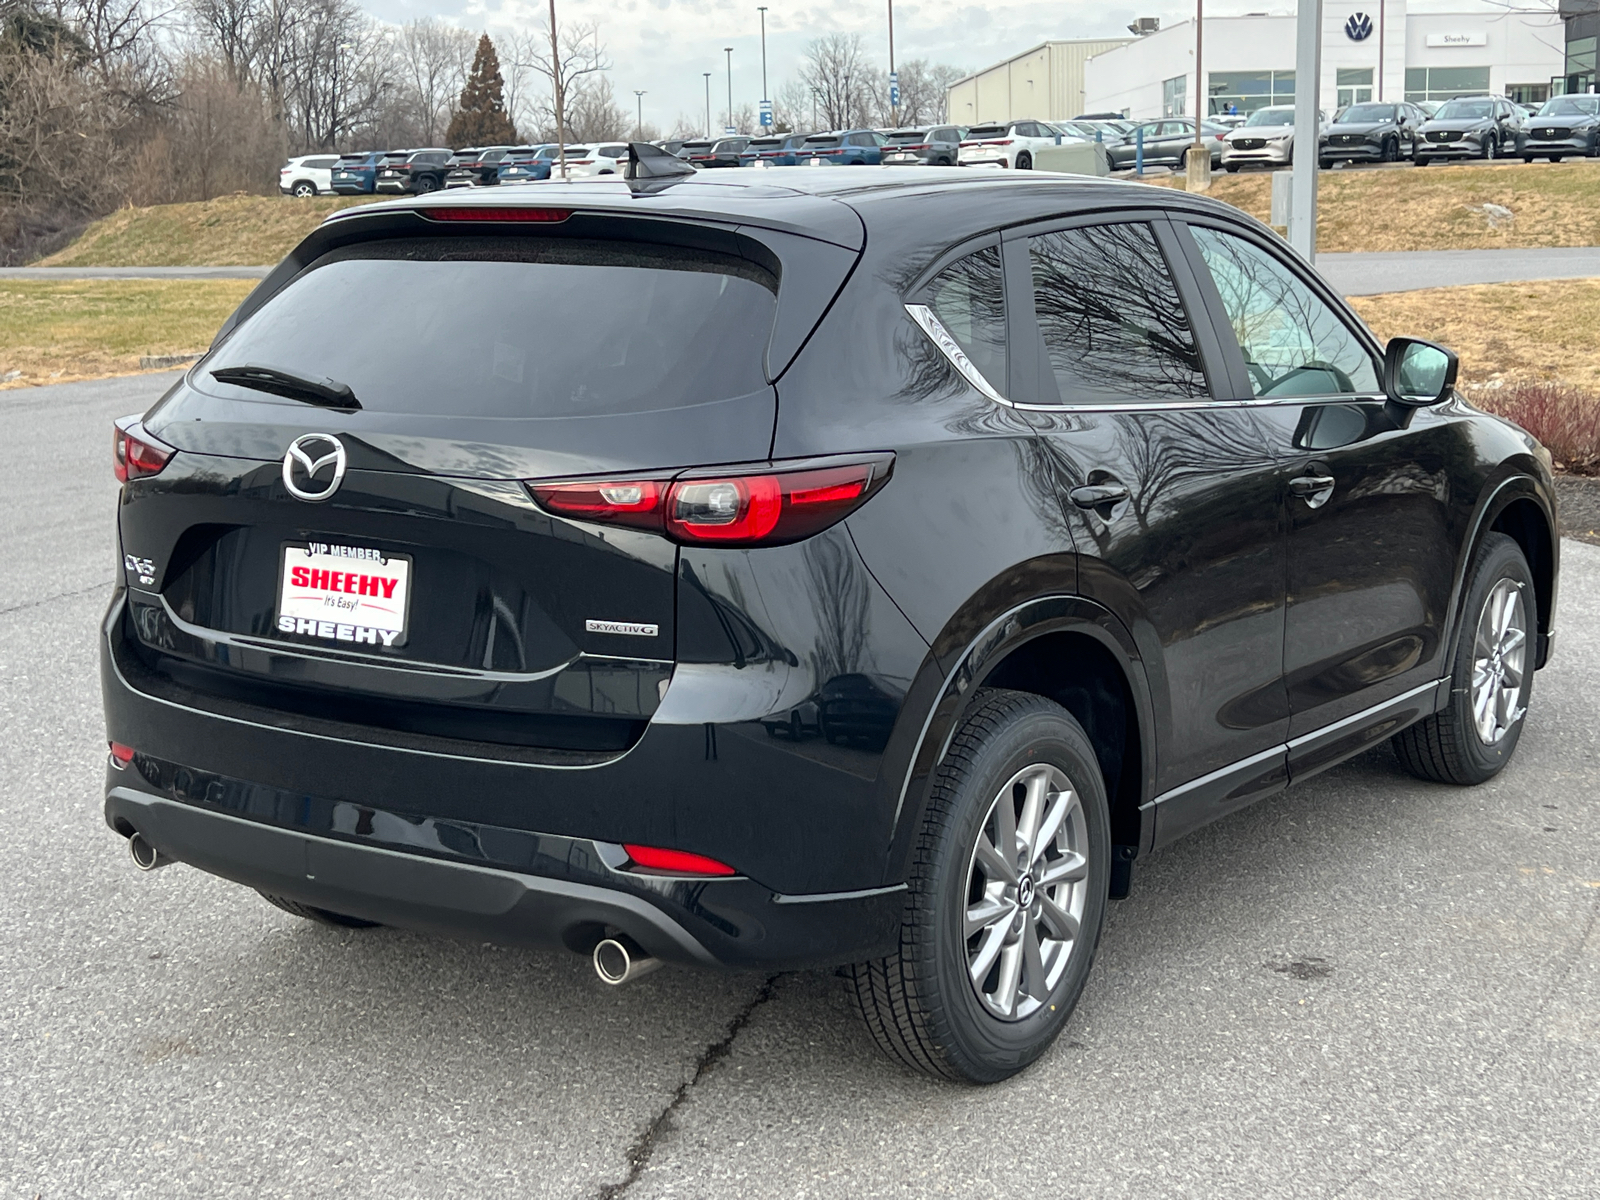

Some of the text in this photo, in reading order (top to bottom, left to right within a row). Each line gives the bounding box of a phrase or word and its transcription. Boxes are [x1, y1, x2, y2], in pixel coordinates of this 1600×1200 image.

[1444, 34, 1470, 45] Sheehy
[308, 542, 381, 562] VIP MEMBER
[291, 566, 399, 599] SHEEHY
[324, 594, 359, 612] It's Easy!
[278, 615, 400, 647] SHEEHY
